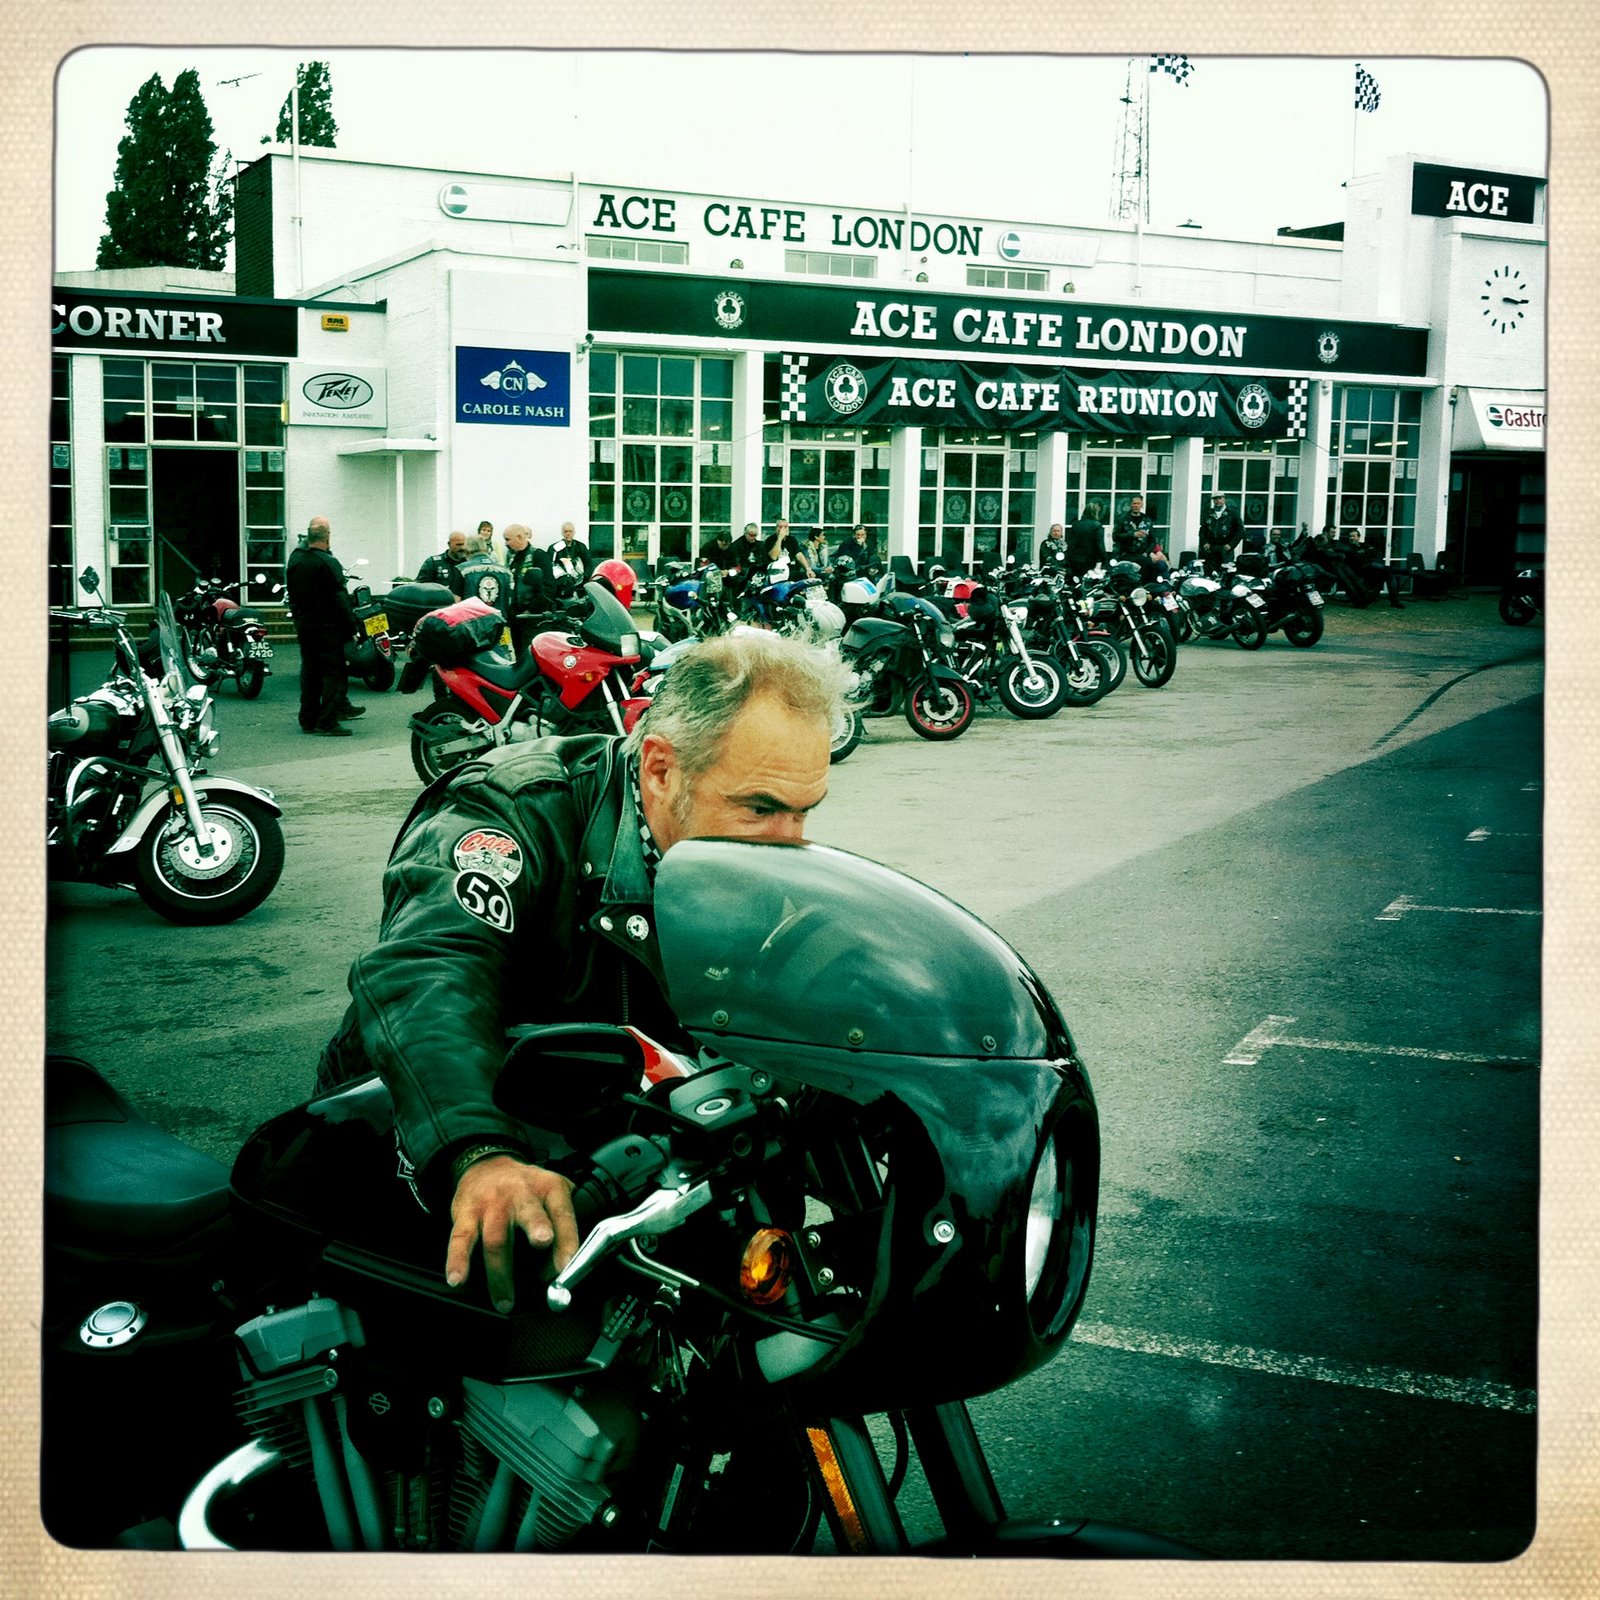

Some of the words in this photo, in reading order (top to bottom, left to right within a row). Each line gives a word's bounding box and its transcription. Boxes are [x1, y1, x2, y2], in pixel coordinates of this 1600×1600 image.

[1446, 180, 1509, 217] ACE
[593, 193, 676, 232] ACE
[703, 203, 806, 243] CAFE
[831, 213, 984, 257] LONDON
[850, 300, 937, 340] ACE
[953, 307, 1063, 348] CAFE
[1075, 315, 1247, 358] LONDON
[502, 377, 524, 391] CN
[829, 367, 845, 384] ACE
[314, 378, 360, 403] PEAVEY
[888, 377, 956, 409] ACE
[975, 382, 1060, 412] CAFE
[1077, 385, 1218, 418] REUNION
[462, 402, 521, 416] CAROLE
[524, 405, 564, 416] NASH
[830, 395, 863, 412] LONDON
[251, 642, 270, 650] SAC
[462, 876, 508, 928] 59
